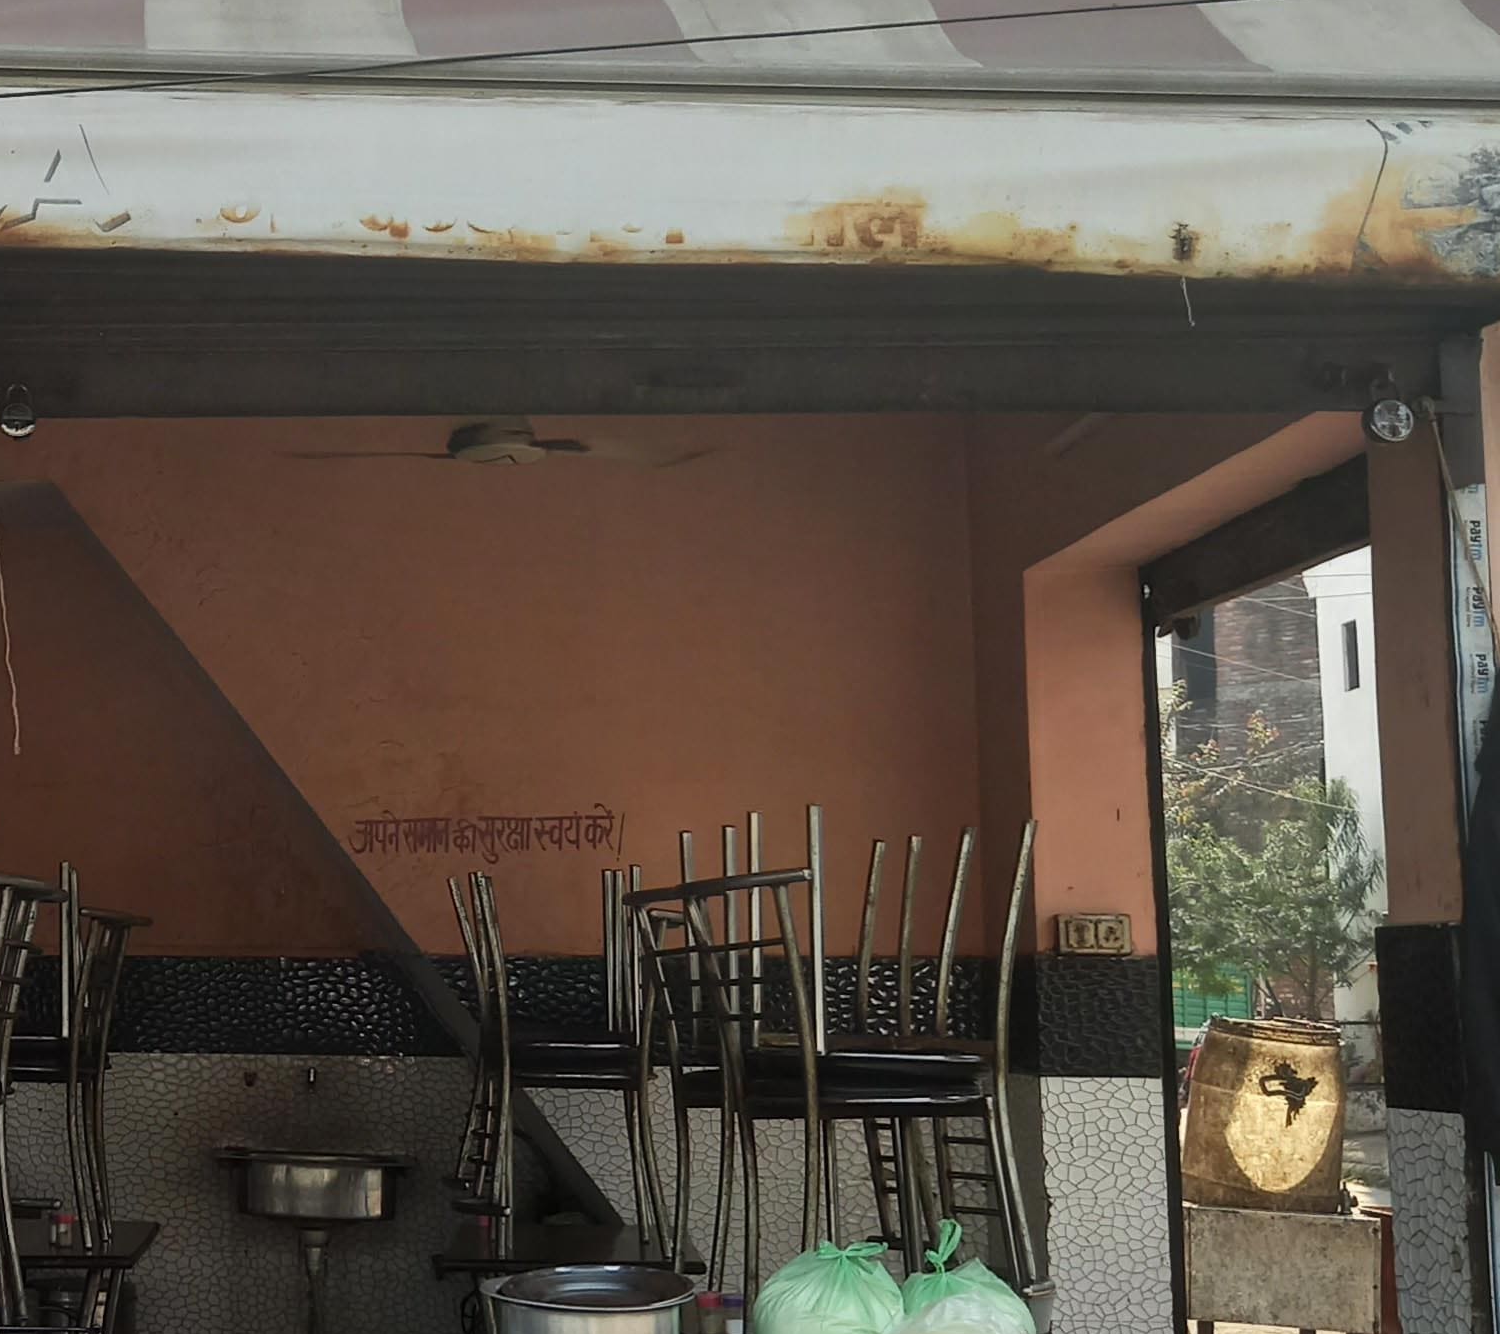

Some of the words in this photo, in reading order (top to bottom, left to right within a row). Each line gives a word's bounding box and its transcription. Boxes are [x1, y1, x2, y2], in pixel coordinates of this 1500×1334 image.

[347, 809, 400, 854] अपने
[452, 818, 477, 854] की
[477, 815, 533, 865] सुरक्षा
